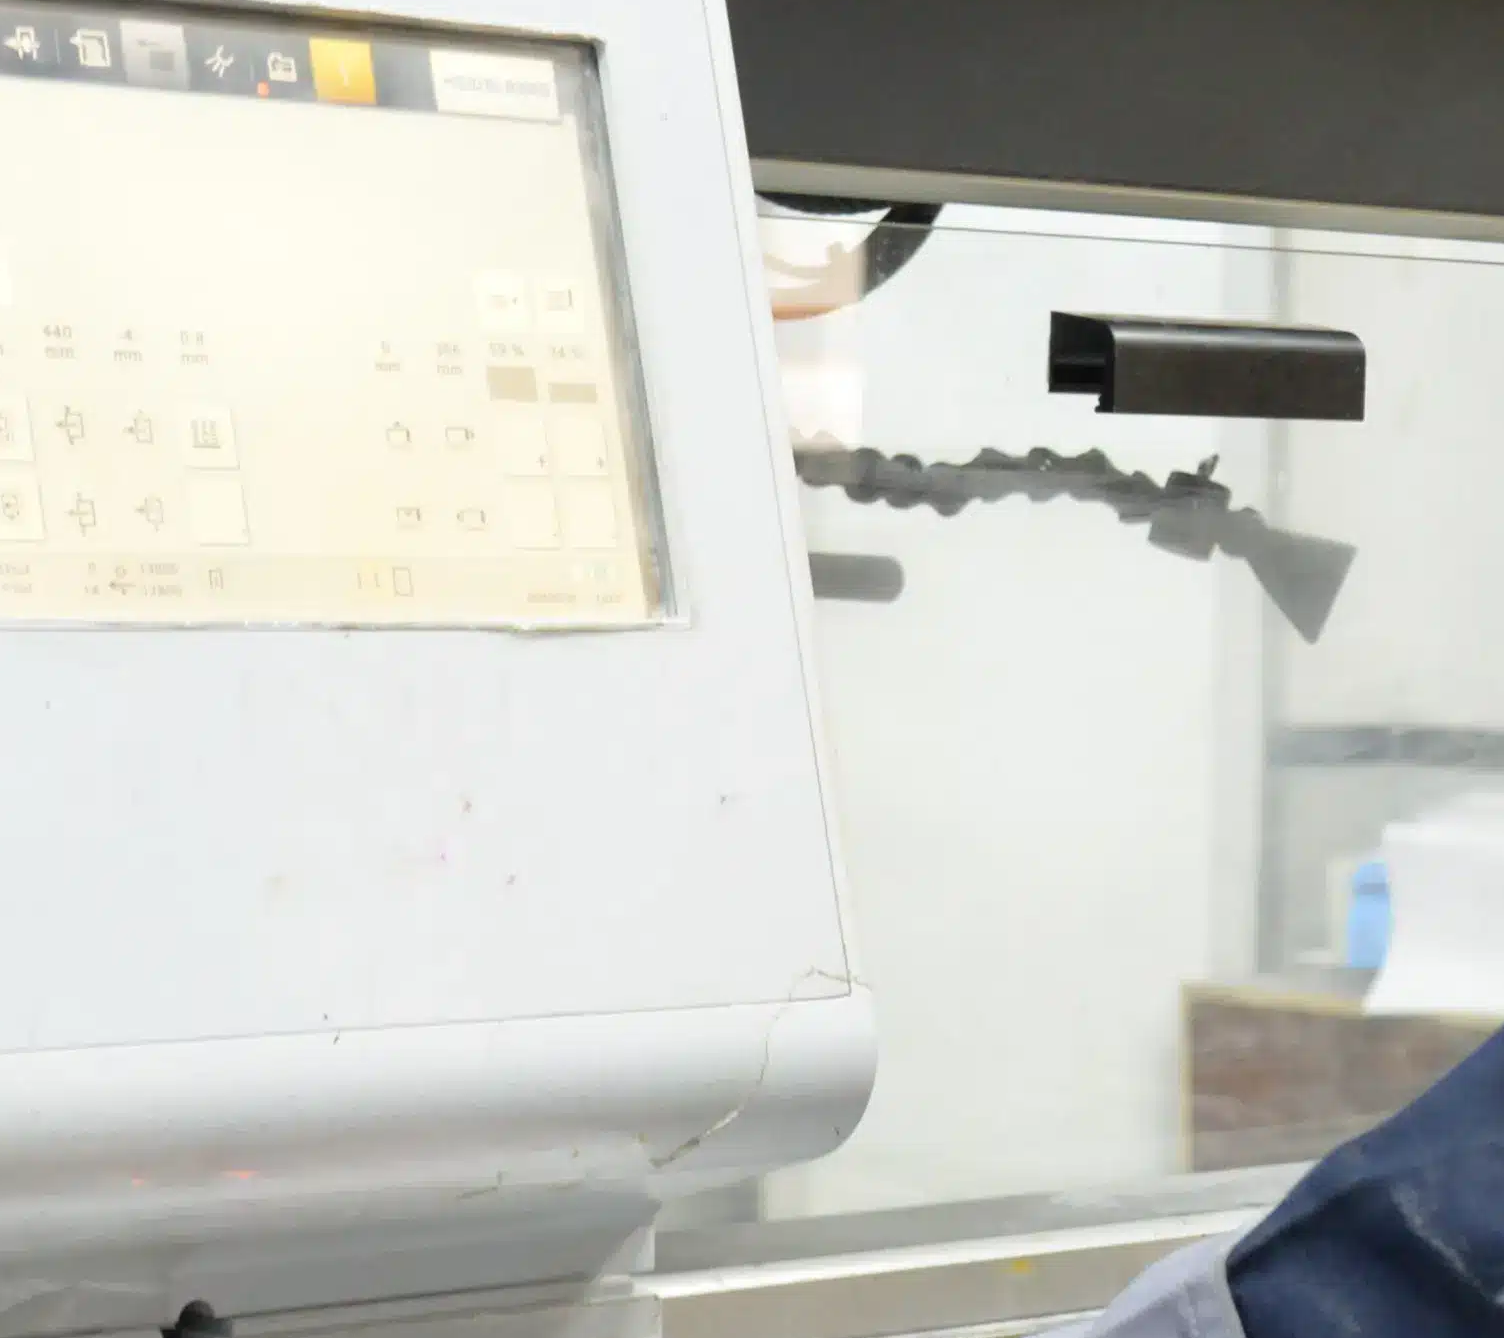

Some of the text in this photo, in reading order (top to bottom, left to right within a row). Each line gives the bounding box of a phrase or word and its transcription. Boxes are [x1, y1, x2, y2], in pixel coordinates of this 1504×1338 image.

[113, 349, 144, 363] mm
[180, 352, 209, 367] mm
[436, 363, 463, 376] mm
